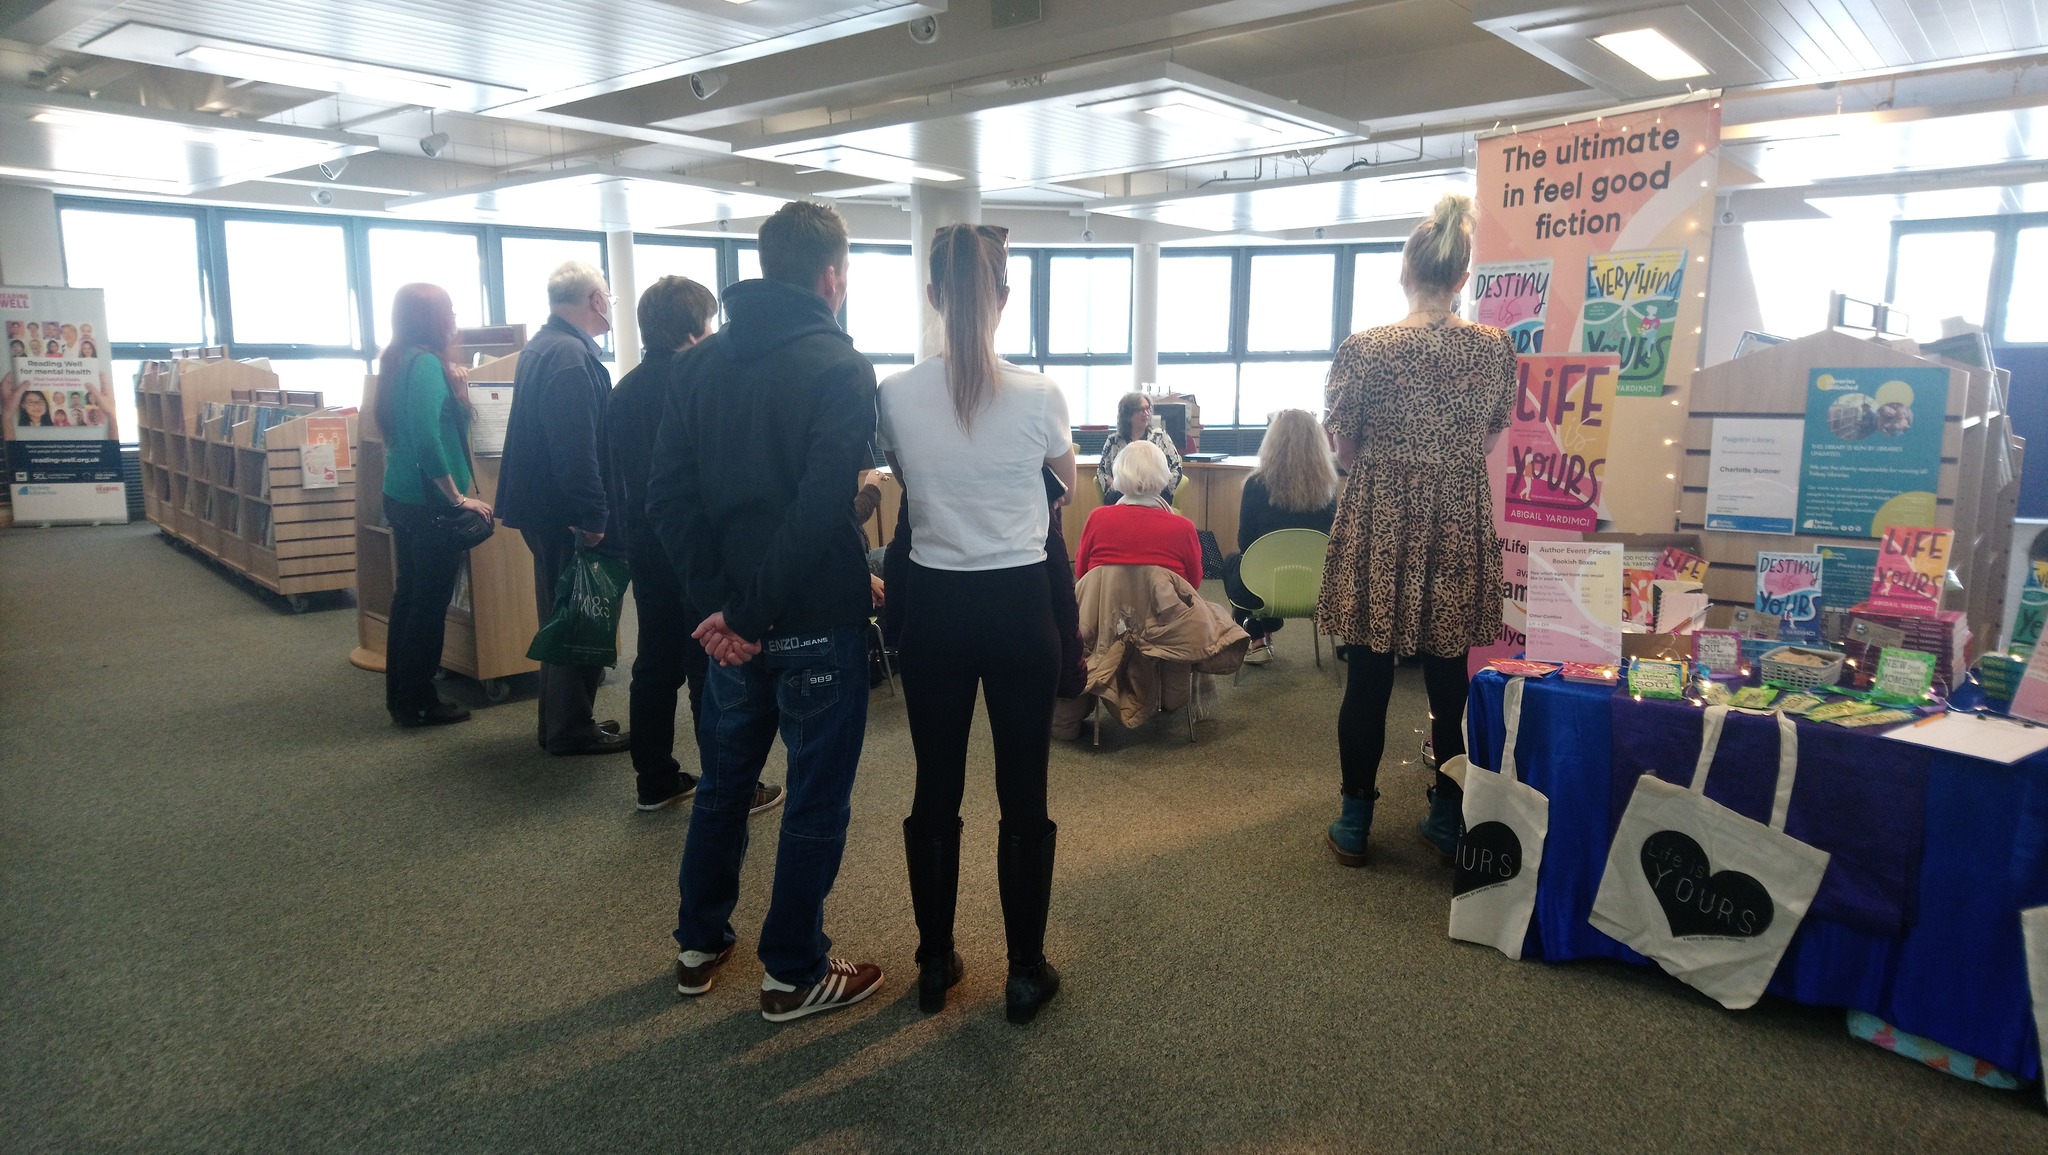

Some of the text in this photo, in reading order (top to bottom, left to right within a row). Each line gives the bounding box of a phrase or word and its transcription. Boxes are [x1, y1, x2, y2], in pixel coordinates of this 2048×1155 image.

[1503, 127, 1680, 173] The ultimate
[1503, 161, 1671, 208] in feel good
[1536, 210, 1620, 240] fiction
[28, 360, 62, 368] Reading
[1617, 385, 1656, 393] YARDIMCI
[1752, 436, 1775, 444] Library
[1511, 510, 1590, 526] ABIGAIL YARDIMCI
[768, 637, 828, 652] ENZO JEANS
[1698, 644, 1723, 653] SOUL
[810, 674, 833, 685] 989
[1648, 841, 1705, 879] Life is
[1655, 862, 1756, 935] YOURS
